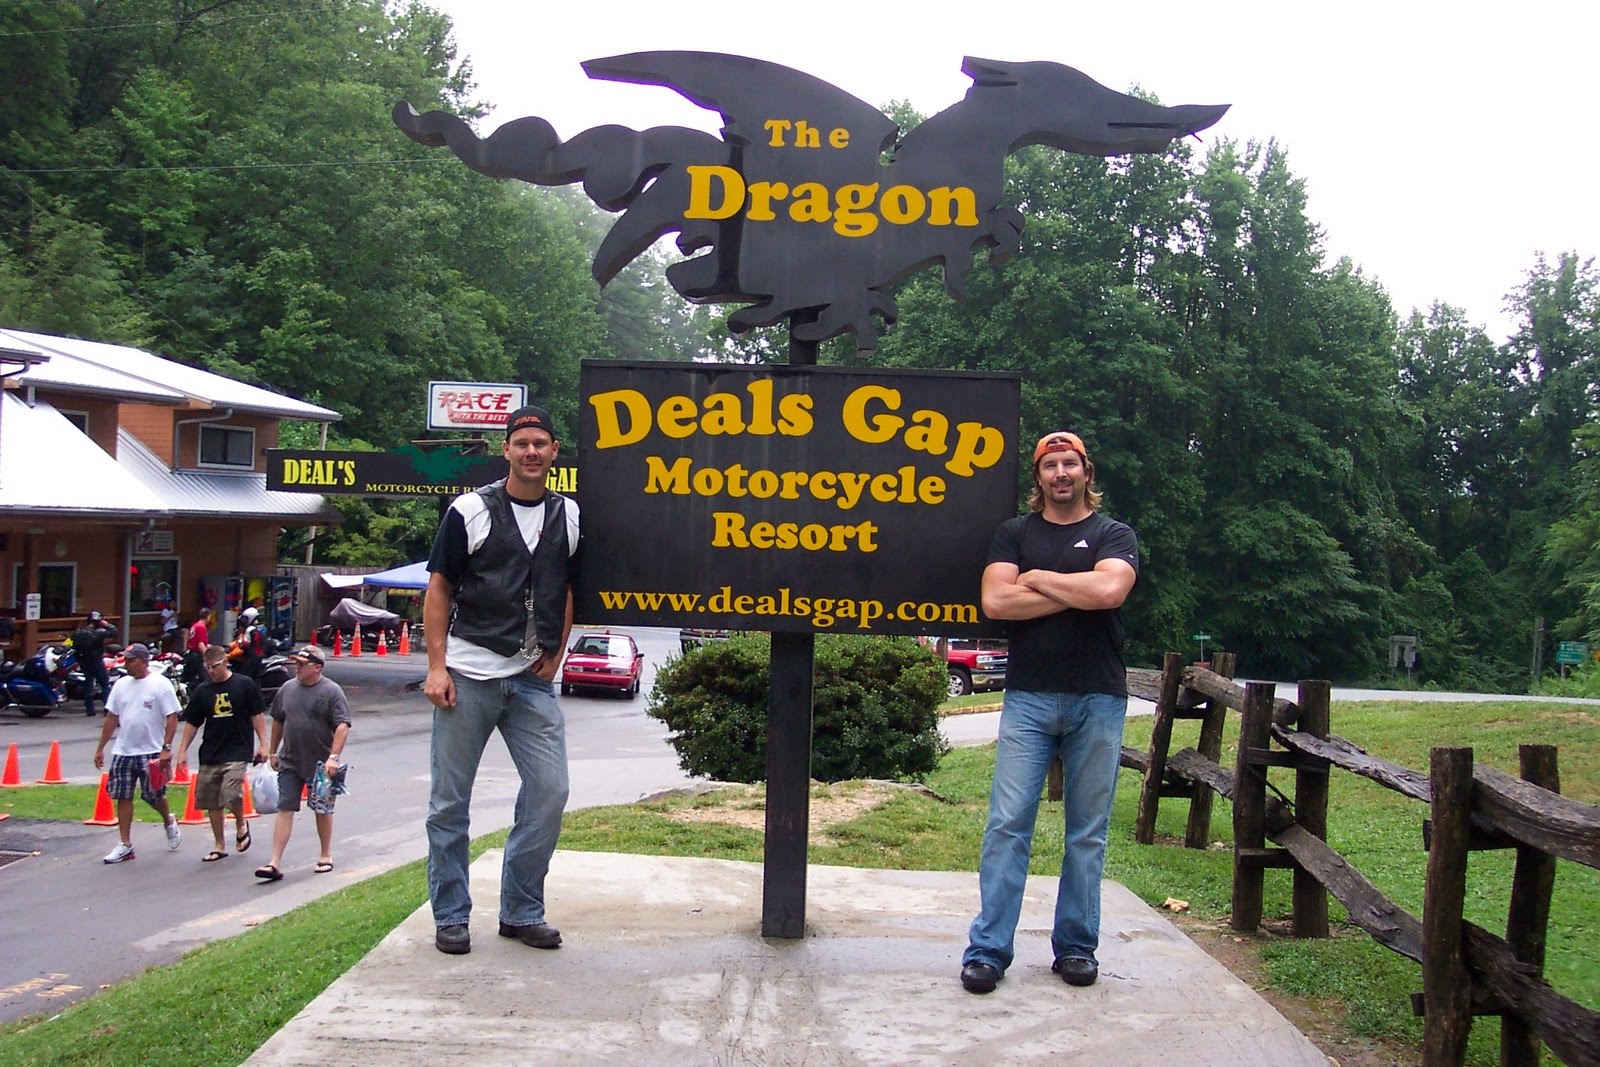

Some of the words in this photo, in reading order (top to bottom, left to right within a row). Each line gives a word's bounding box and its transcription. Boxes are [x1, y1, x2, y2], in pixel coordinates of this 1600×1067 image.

[763, 119, 850, 149] The
[683, 164, 980, 238] Dragon
[437, 391, 513, 410] RACE
[472, 413, 487, 421] THE
[487, 413, 508, 421] BEST
[588, 376, 815, 451] Deals
[841, 384, 1005, 479] Gap
[283, 459, 356, 485] DEAL'S
[366, 483, 460, 495] MOTORCYCLE
[643, 455, 947, 511] Motorcycle
[711, 511, 879, 553] Resort
[598, 585, 979, 629] www.dealsgap.com
